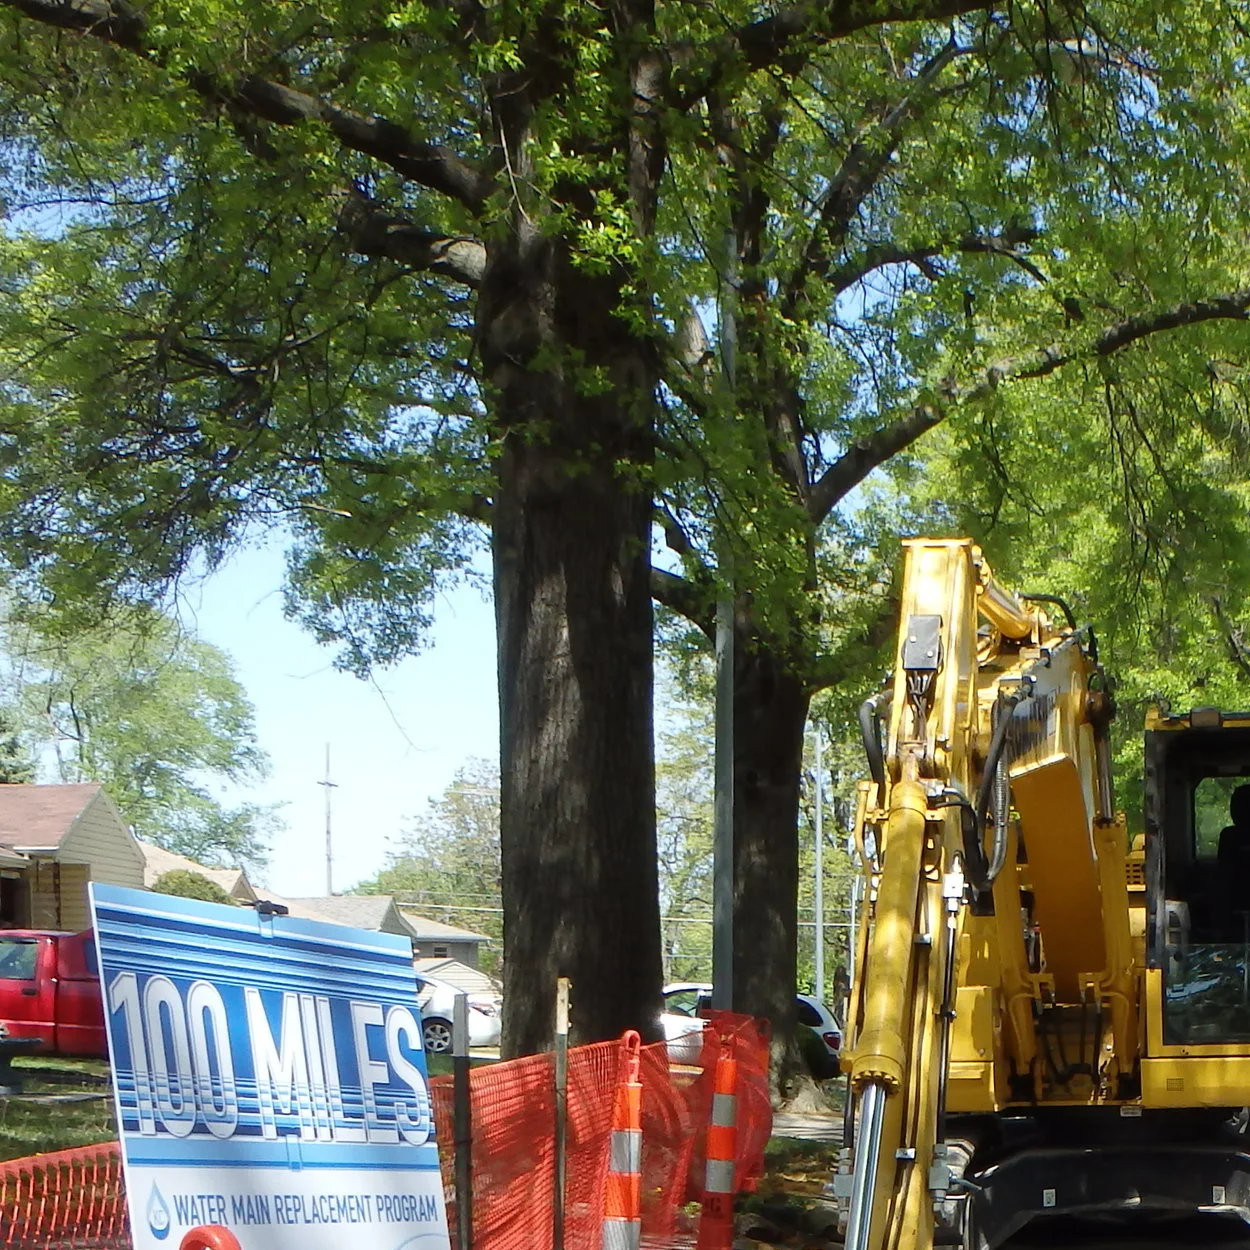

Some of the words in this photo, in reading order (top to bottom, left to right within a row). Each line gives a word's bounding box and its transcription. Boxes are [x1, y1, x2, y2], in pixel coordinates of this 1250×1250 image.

[109, 971, 239, 1139] 100
[245, 986, 430, 1146] MILES
[173, 1194, 228, 1225] WATER
[231, 1194, 272, 1225] MAIN
[274, 1194, 373, 1225] REPLACEMENT
[376, 1194, 438, 1222] PROGRAM
